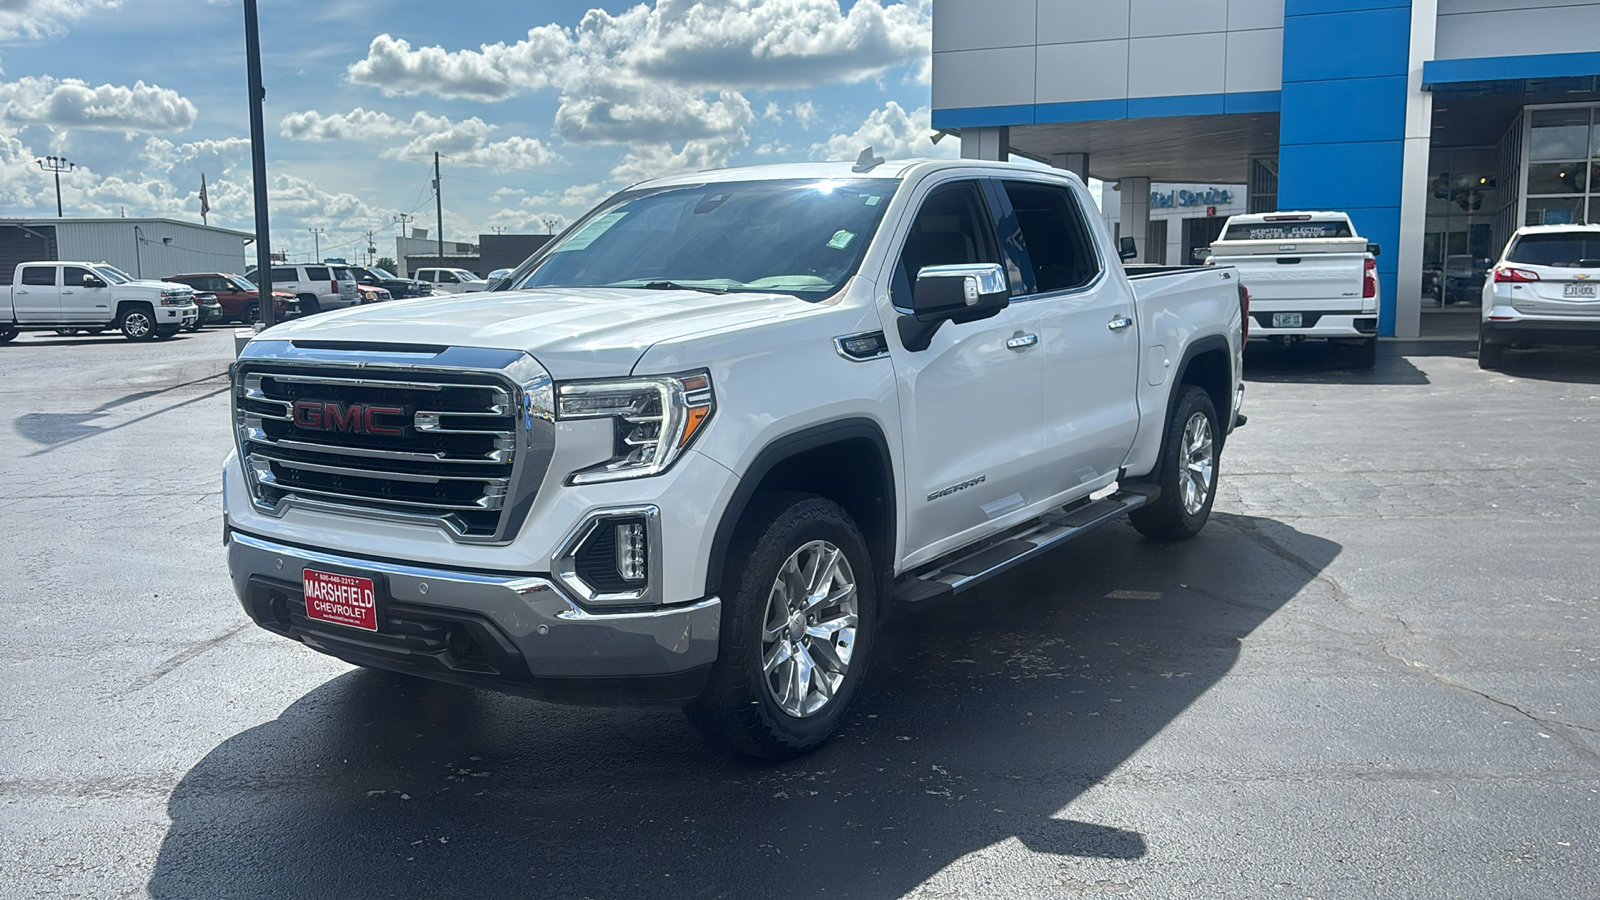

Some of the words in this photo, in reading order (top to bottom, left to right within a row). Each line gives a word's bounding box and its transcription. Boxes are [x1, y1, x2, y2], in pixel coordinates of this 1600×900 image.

[1179, 187, 1229, 207] Service
[1250, 227, 1283, 235] WEBSTER
[1291, 226, 1325, 234] ELECTRIC
[292, 400, 403, 434] GMC
[927, 474, 985, 501] SIERRA
[305, 579, 373, 608] MARSHFIELD
[314, 600, 366, 619] CHEVROLET
